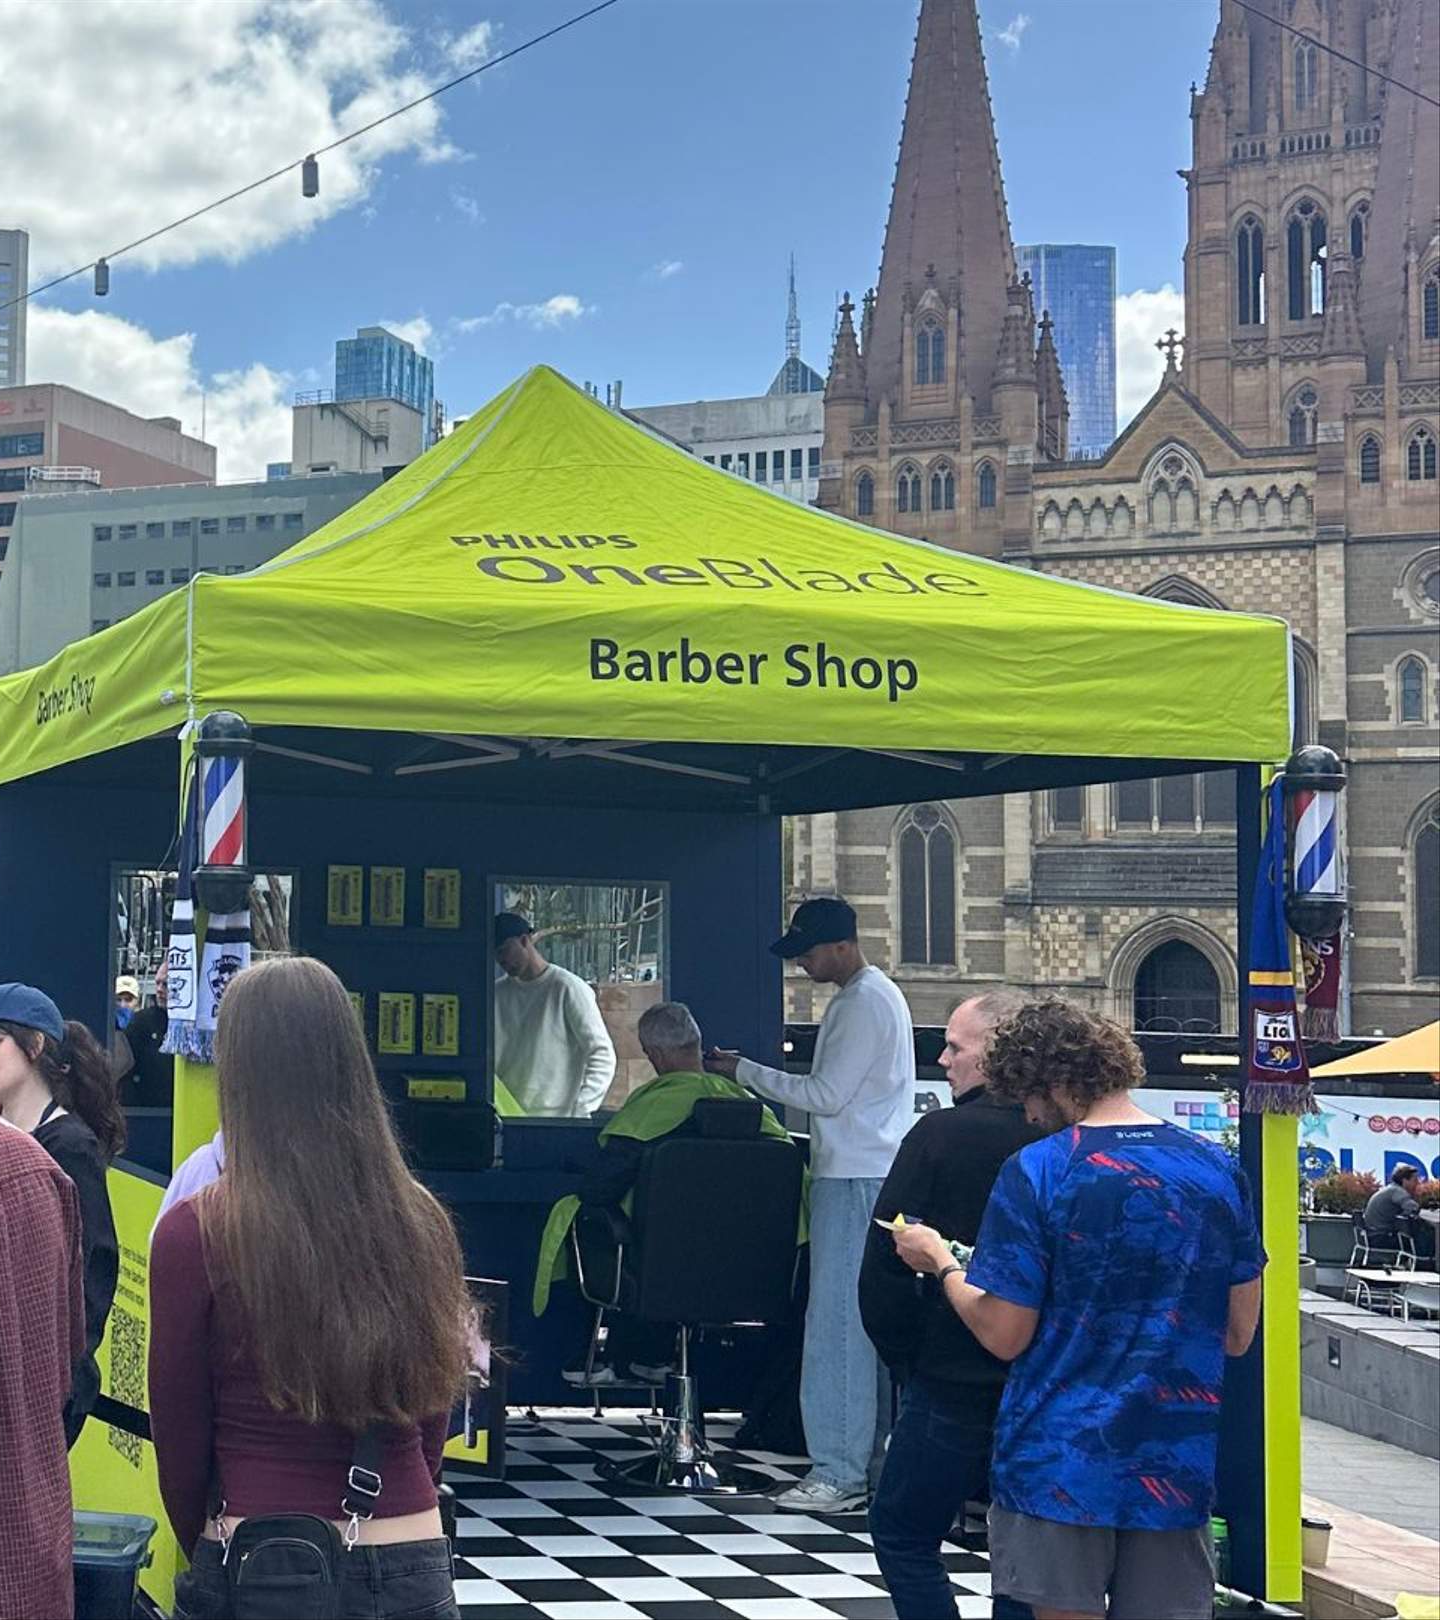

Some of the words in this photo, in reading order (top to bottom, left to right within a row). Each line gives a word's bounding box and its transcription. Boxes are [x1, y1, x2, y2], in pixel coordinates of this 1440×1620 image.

[449, 533, 638, 550] PHILIPS
[476, 555, 989, 597] OneBlade
[589, 637, 769, 685] Barber
[785, 641, 919, 702] Shop
[36, 684, 69, 726] Barber
[68, 671, 96, 716] Shop
